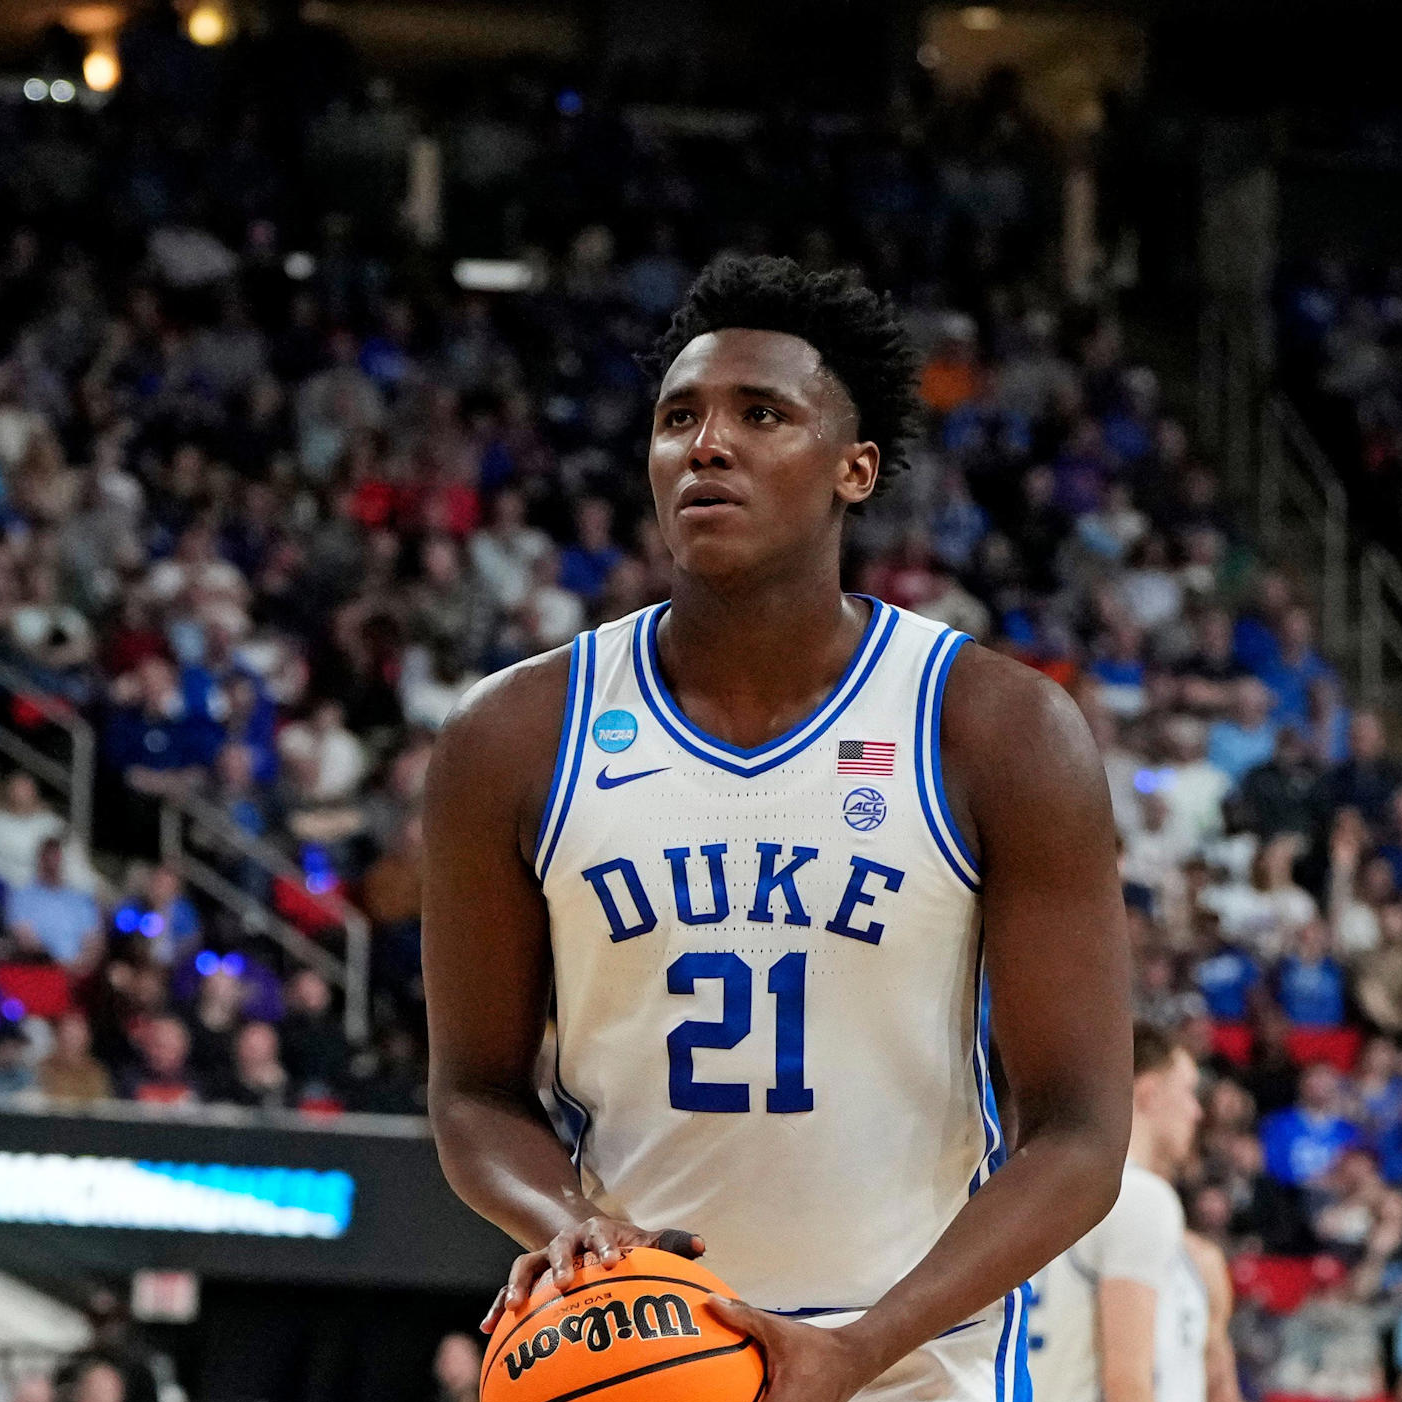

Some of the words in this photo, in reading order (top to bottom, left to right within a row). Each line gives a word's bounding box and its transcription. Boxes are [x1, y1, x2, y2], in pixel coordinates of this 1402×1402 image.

[598, 729, 635, 741] NCAA
[581, 842, 905, 945] DUKE
[666, 952, 814, 1113] 21
[504, 1293, 701, 1381] Wilson
[585, 1293, 612, 1305] EVO
